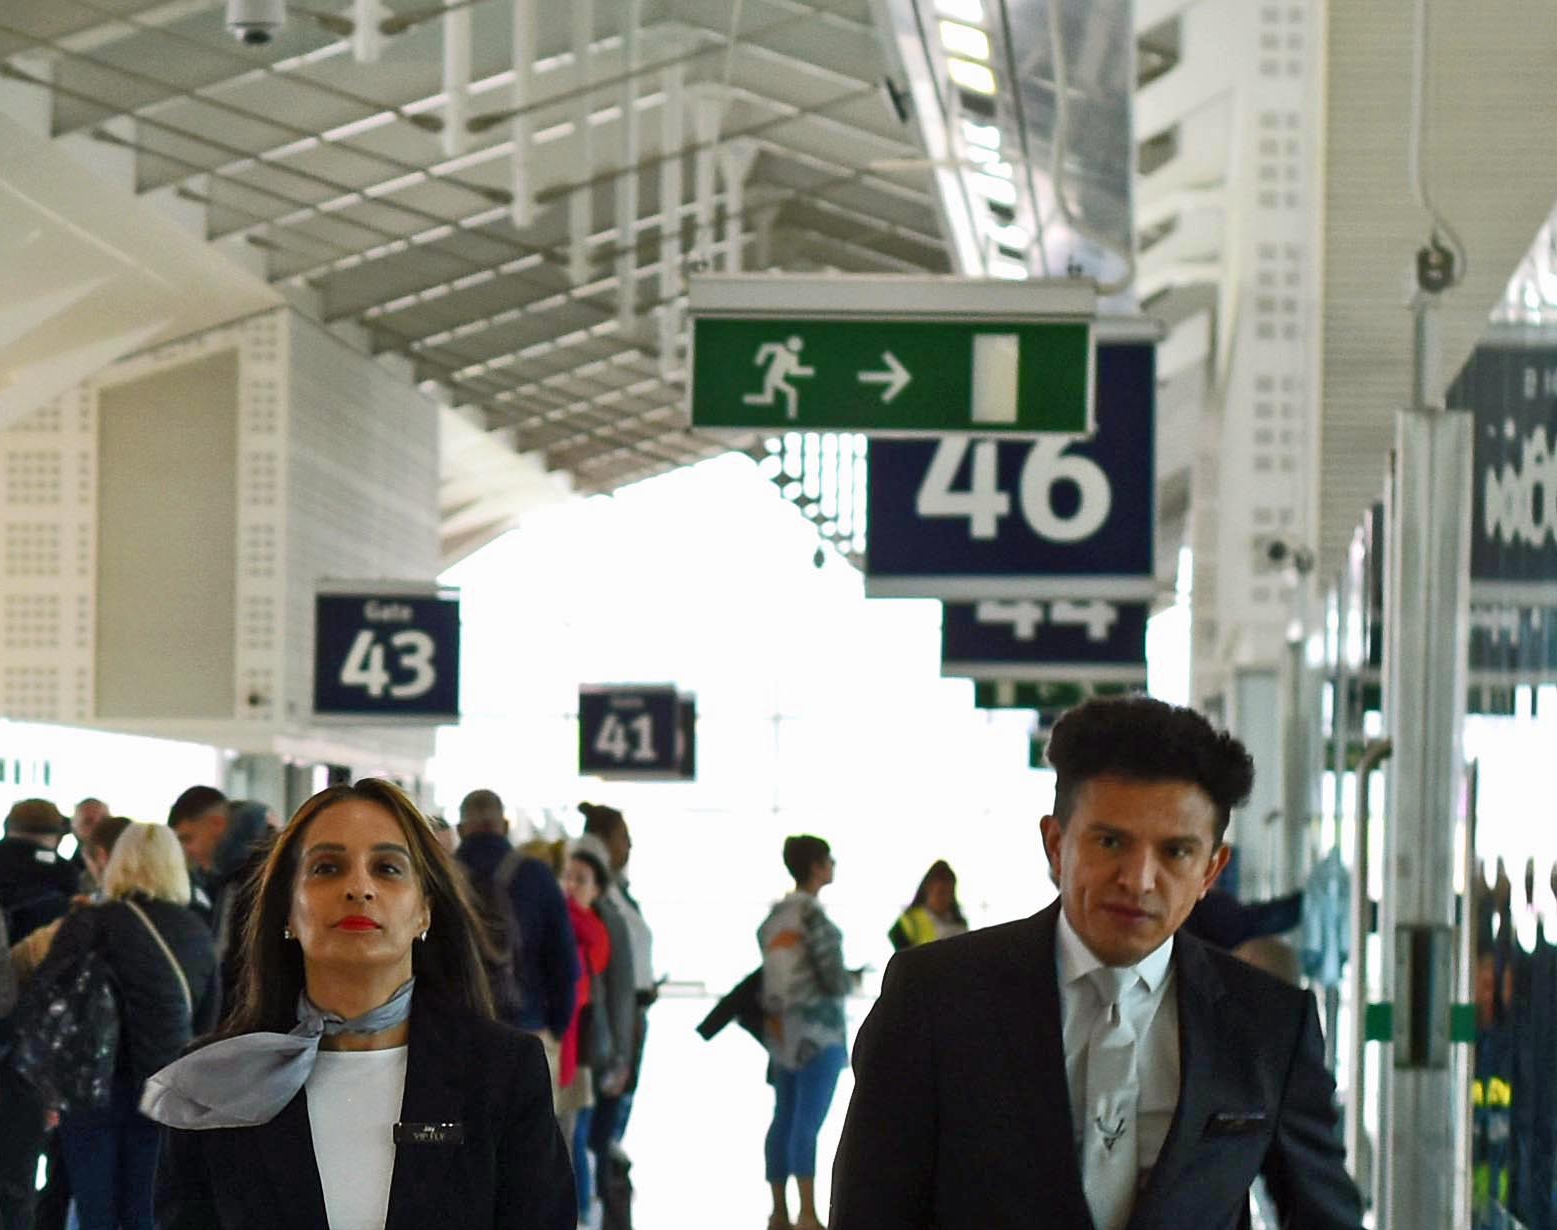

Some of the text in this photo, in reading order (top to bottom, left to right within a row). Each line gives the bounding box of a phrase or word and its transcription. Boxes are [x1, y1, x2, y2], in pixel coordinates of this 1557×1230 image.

[916, 433, 1112, 543] 46
[340, 629, 437, 698] 43
[595, 714, 658, 761] 41
